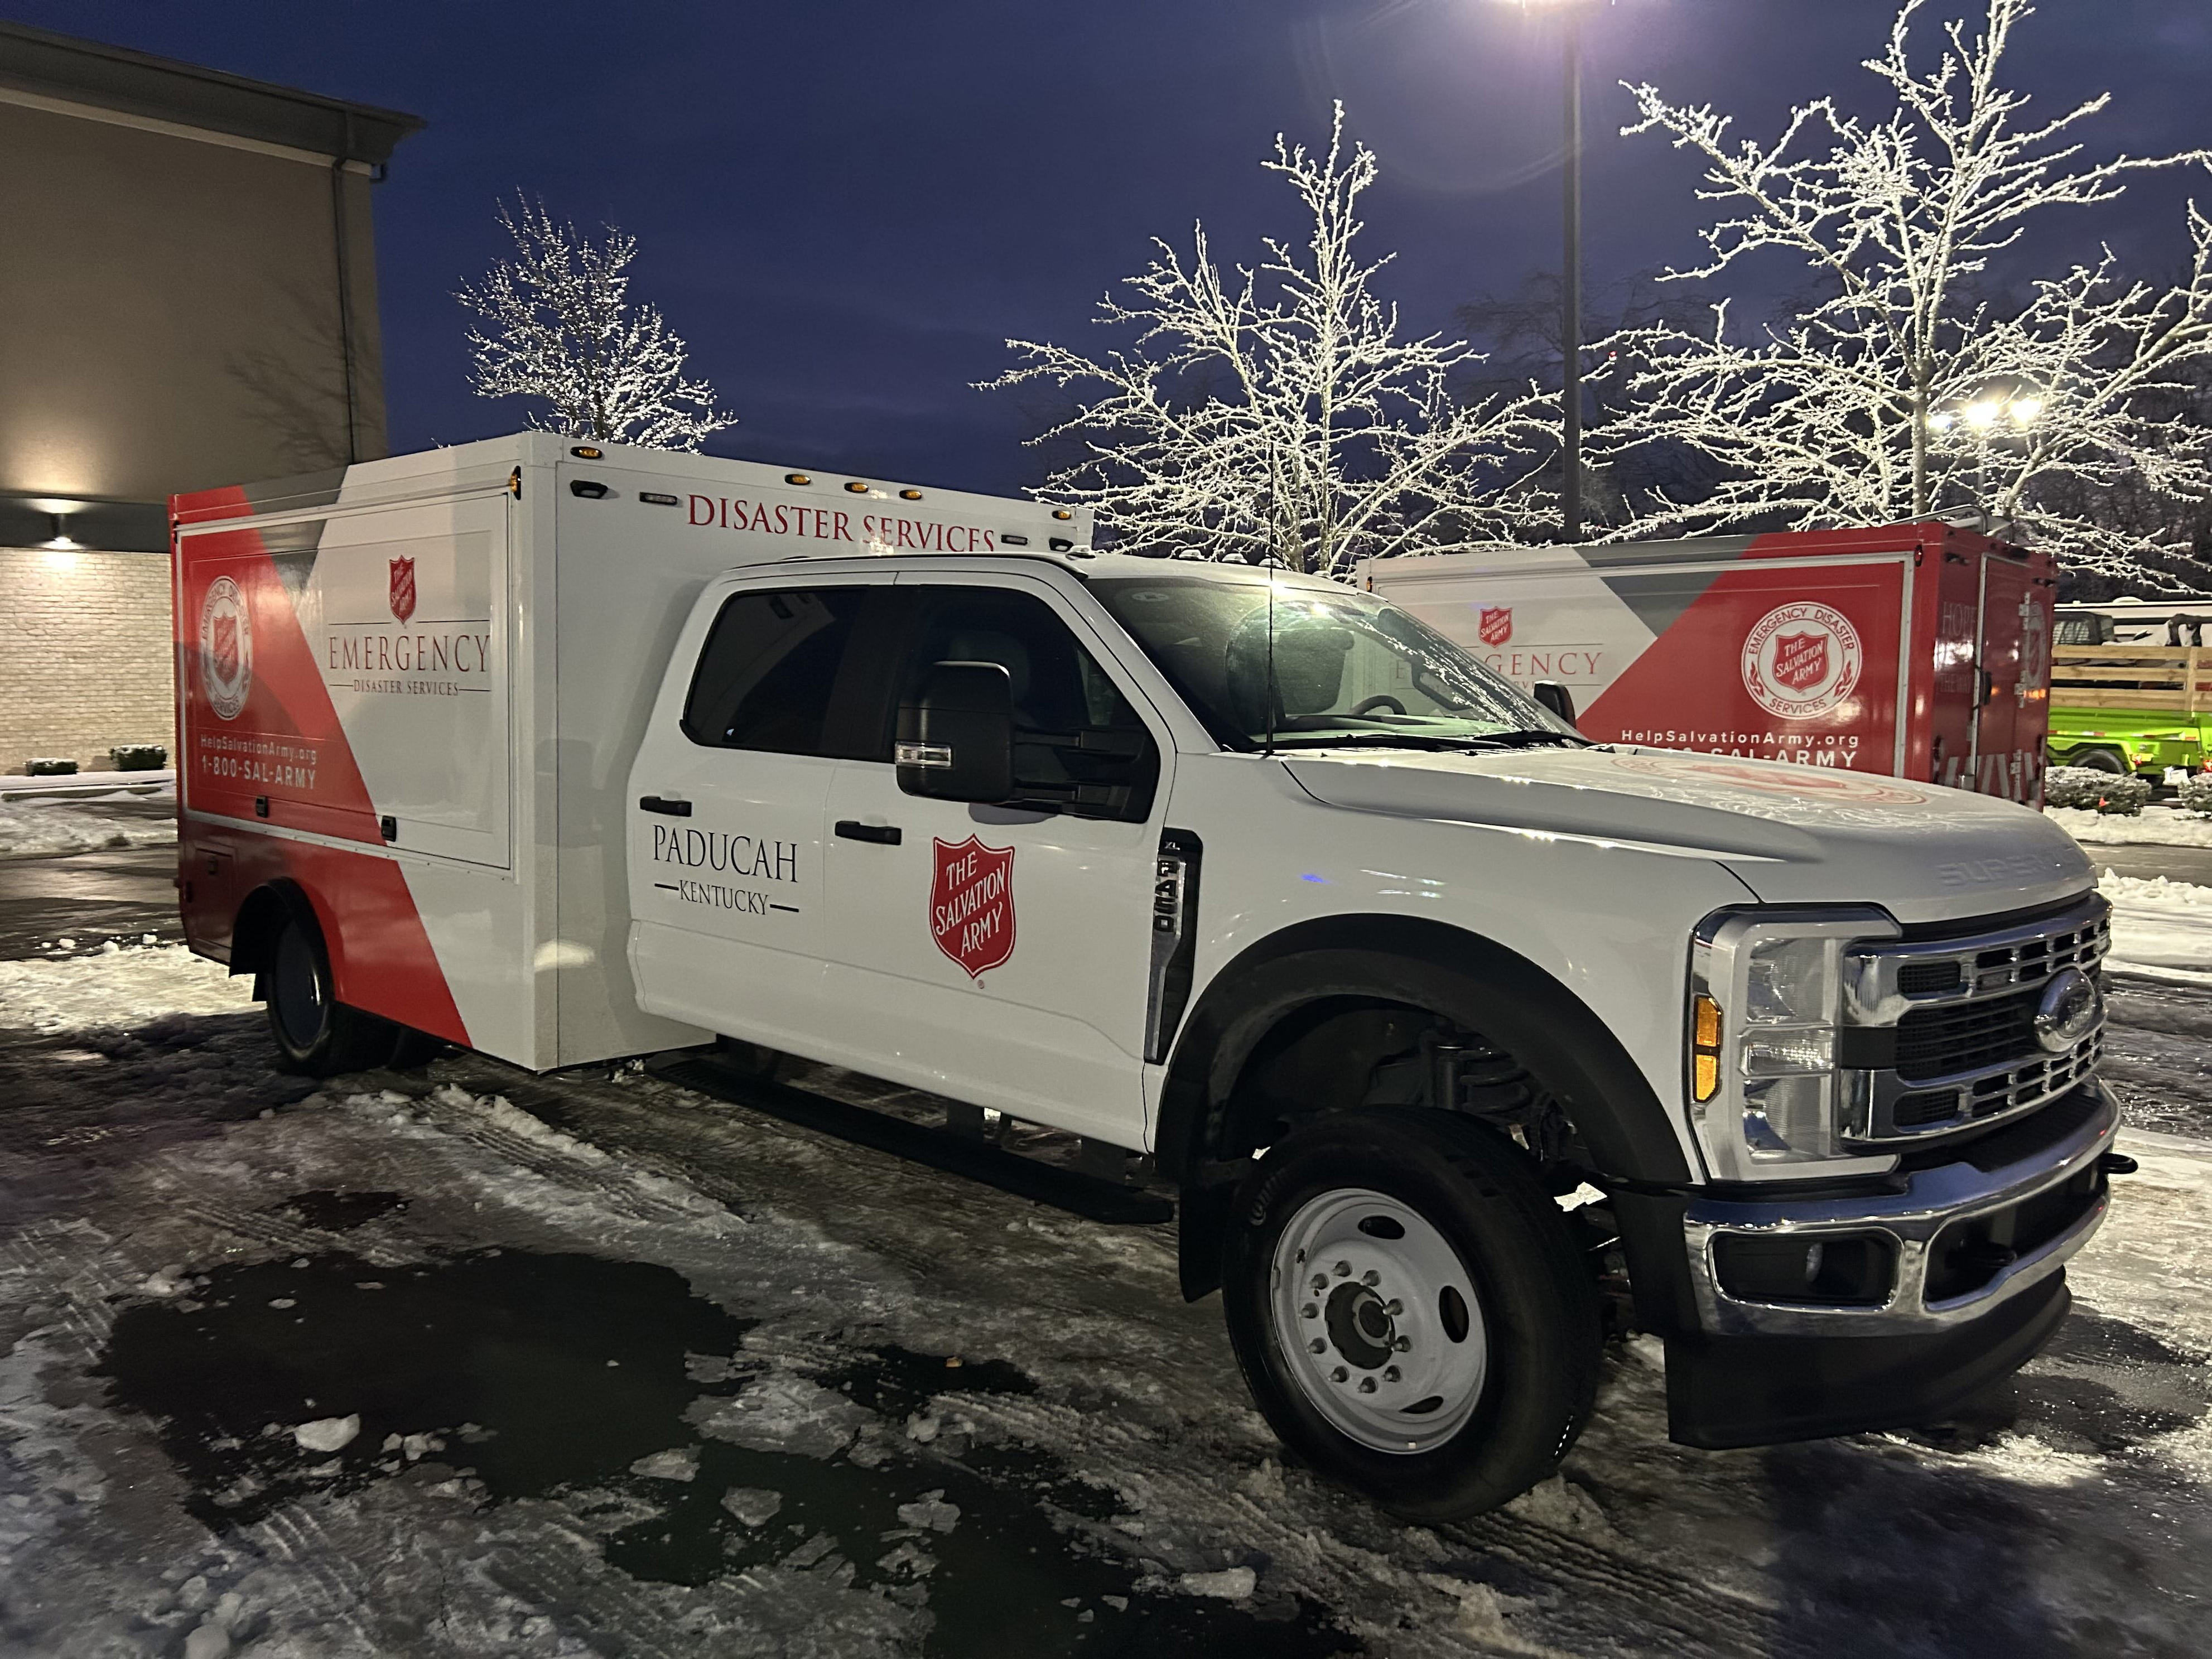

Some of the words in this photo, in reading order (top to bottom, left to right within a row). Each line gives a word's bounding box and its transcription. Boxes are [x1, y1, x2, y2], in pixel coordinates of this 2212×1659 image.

[687, 494, 854, 542] DISASTER
[1480, 612, 1510, 638] SALVATION
[1486, 610, 1498, 624] THE
[1490, 625, 1509, 642] ARMY
[1748, 607, 1807, 655] EMERGENCY
[1814, 609, 1855, 650] DISASTER
[329, 634, 490, 672] EMERGENCY
[1775, 640, 1823, 678] SALVATION
[1784, 638, 1806, 657] THE
[354, 679, 402, 694] DISASTER
[407, 681, 459, 696] SERVICES
[1791, 657, 1821, 685] ARMY
[1769, 698, 1827, 714] SERVICES
[201, 734, 317, 765] HelpSalvationArmy.org
[1621, 729, 1859, 748] HelpSalvationArmy.org
[201, 755, 316, 790] 1-800-SAL-ARMY
[653, 824, 798, 883] PADUCAH
[946, 851, 978, 891] THE
[679, 879, 769, 915] KENTUCKY
[936, 861, 1005, 936] SALVATION
[960, 901, 1003, 958] ARMY
